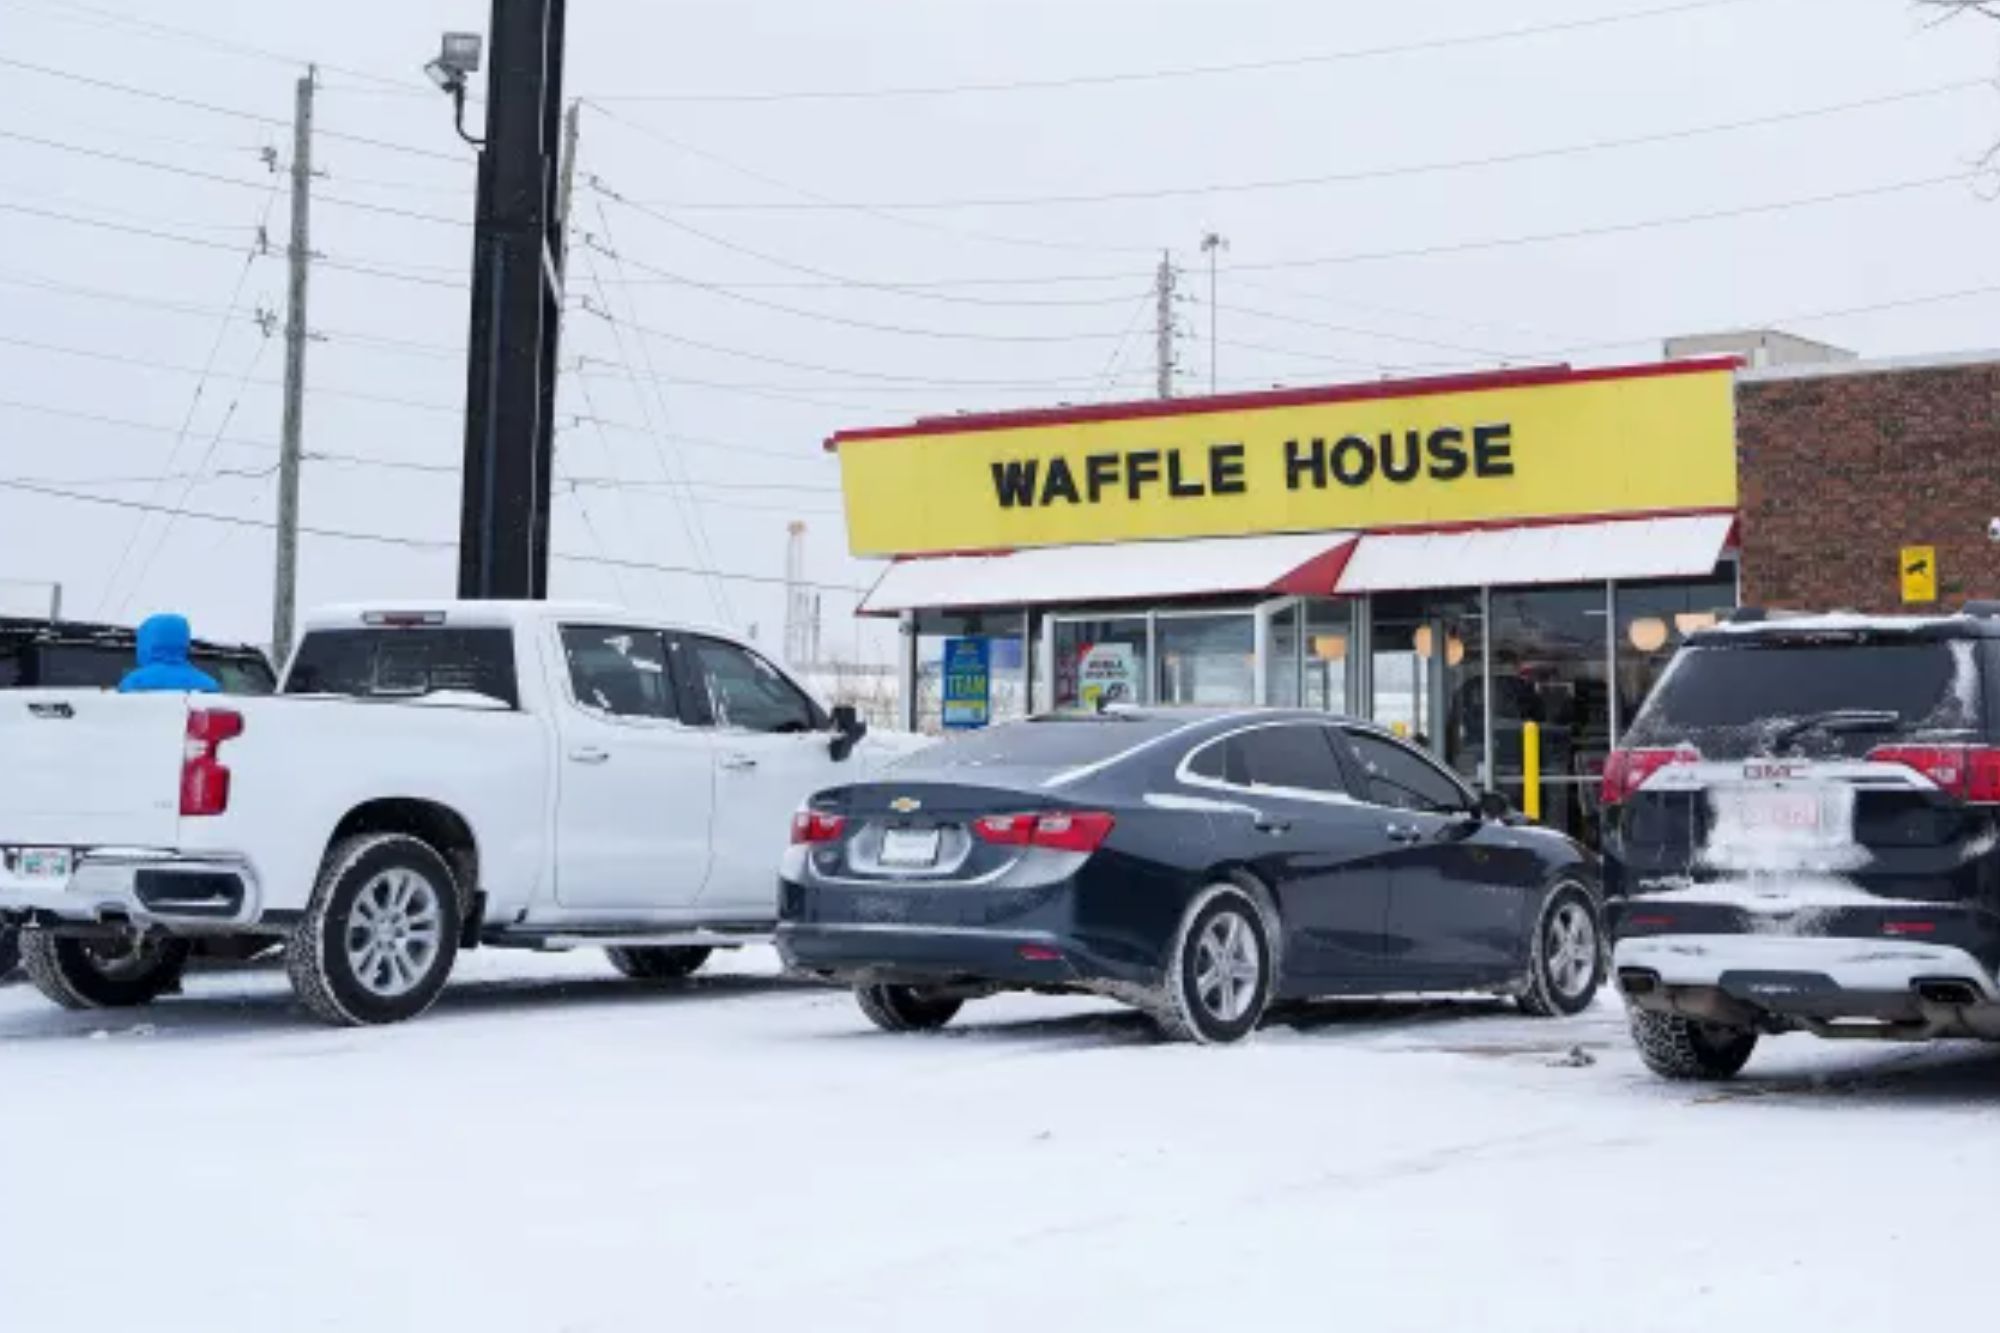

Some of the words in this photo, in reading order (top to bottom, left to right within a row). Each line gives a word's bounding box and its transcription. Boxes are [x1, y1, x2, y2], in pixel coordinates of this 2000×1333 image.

[990, 444, 1246, 508] WAFFLE
[1284, 424, 1514, 489] HOUSE
[947, 674, 986, 697] TEAM
[1742, 764, 1808, 779] GMC
